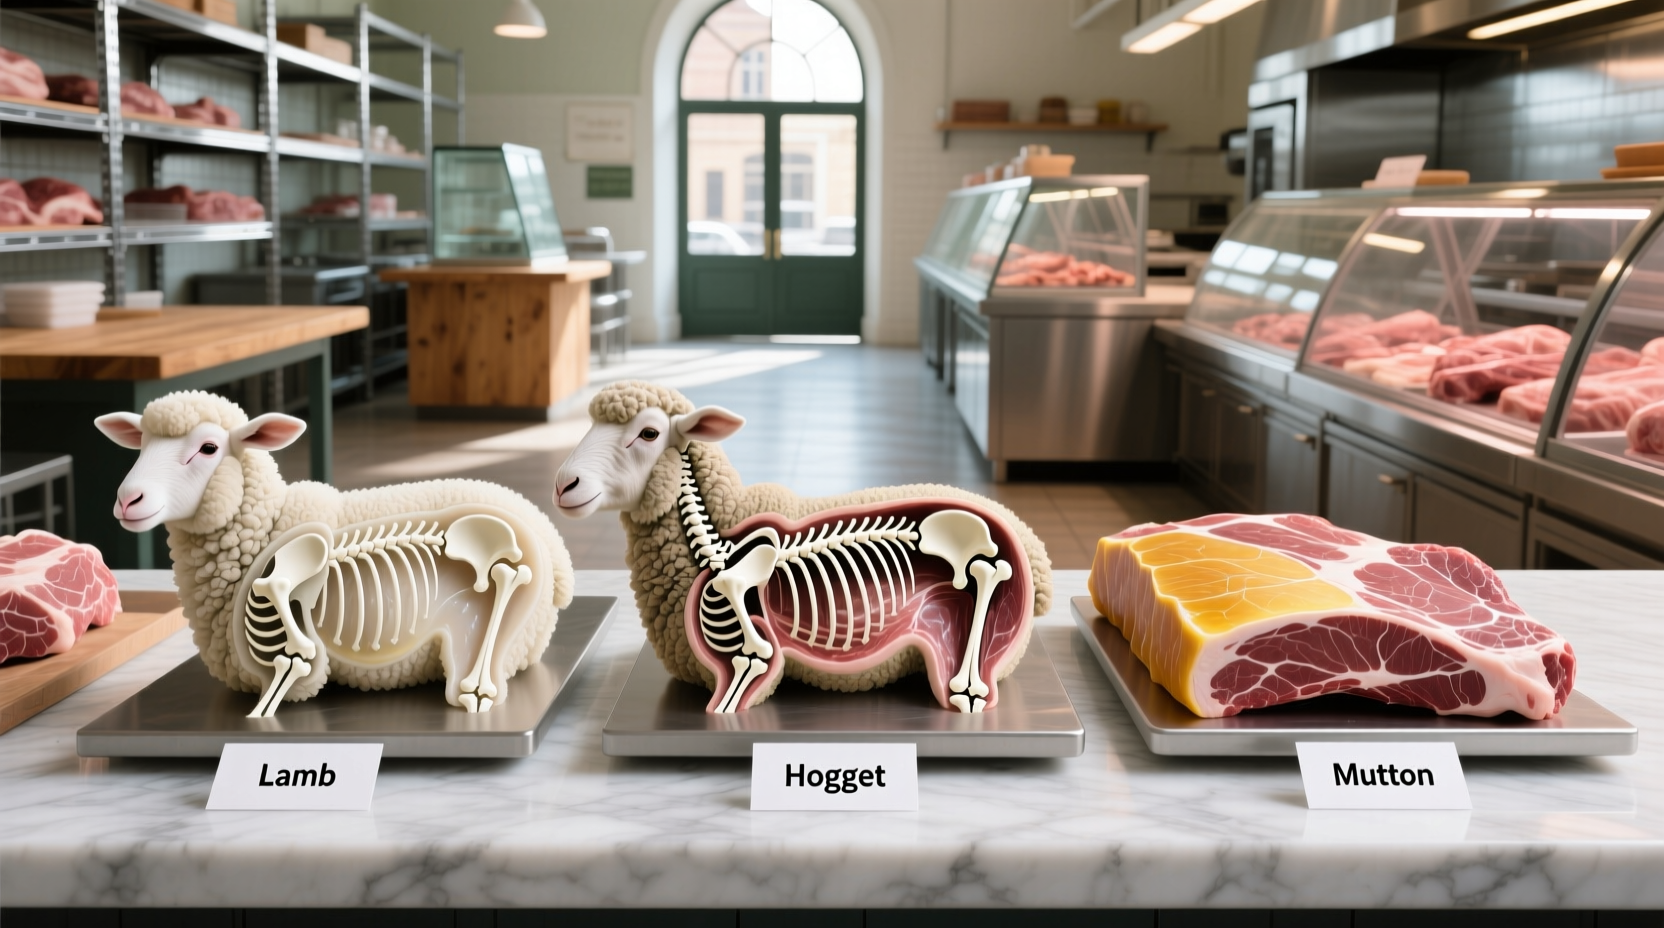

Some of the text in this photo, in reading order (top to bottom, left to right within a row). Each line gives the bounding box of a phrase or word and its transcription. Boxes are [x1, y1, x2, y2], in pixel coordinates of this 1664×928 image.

[258, 762, 336, 787] Lamb
[785, 763, 886, 794] Hogget
[1332, 762, 1435, 787] Mutton
